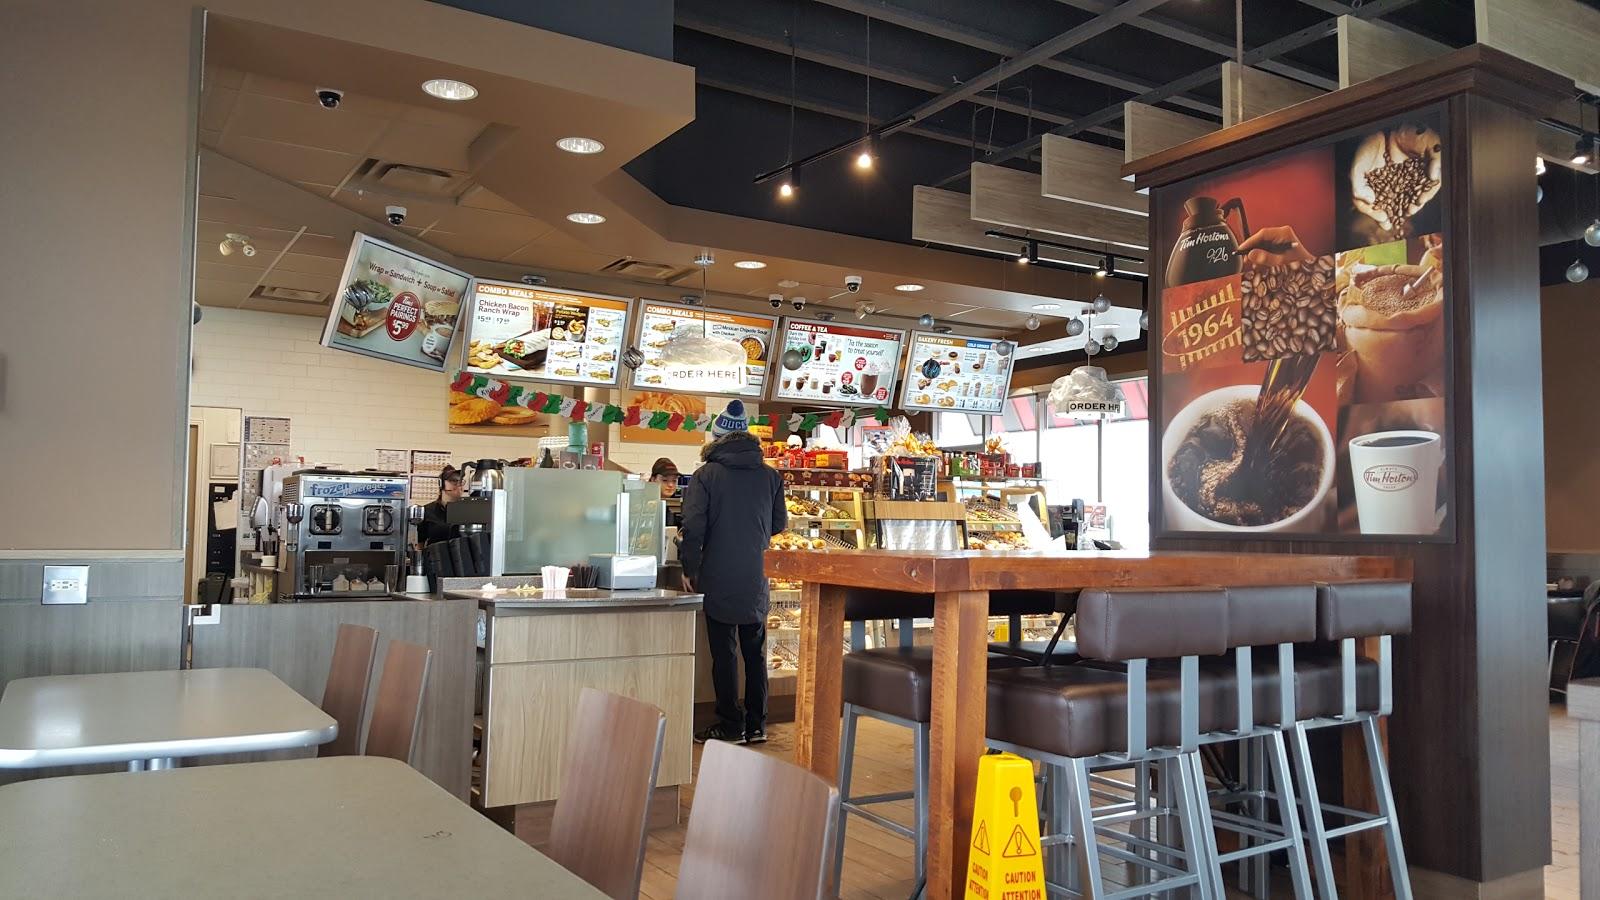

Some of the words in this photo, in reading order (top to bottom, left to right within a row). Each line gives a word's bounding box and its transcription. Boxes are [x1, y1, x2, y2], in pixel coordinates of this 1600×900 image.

[1180, 236, 1195, 251] Tim
[1196, 231, 1229, 247] Hortons
[369, 261, 385, 274] Wrap
[389, 269, 416, 285] Sandwich
[478, 285, 508, 296] COMBO
[509, 289, 534, 299] MEALS
[393, 302, 419, 316] PERFECT
[478, 306, 501, 315] Ranch
[502, 308, 521, 318] Wrap
[479, 299, 507, 309] Chicken
[508, 303, 530, 312] Bacon
[647, 306, 672, 315] COMBO
[672, 309, 695, 318] MEALS
[390, 309, 417, 323] PAIRINGS
[790, 323, 812, 332] COFFEE
[1178, 308, 1235, 349] 1964
[865, 349, 885, 357] yourself
[1069, 402, 1106, 411] ORDER
[1365, 471, 1381, 483] Tim
[310, 482, 350, 496] frozen
[1005, 871, 1036, 884] CAUTION
[1002, 889, 1041, 900] ATTENTION
